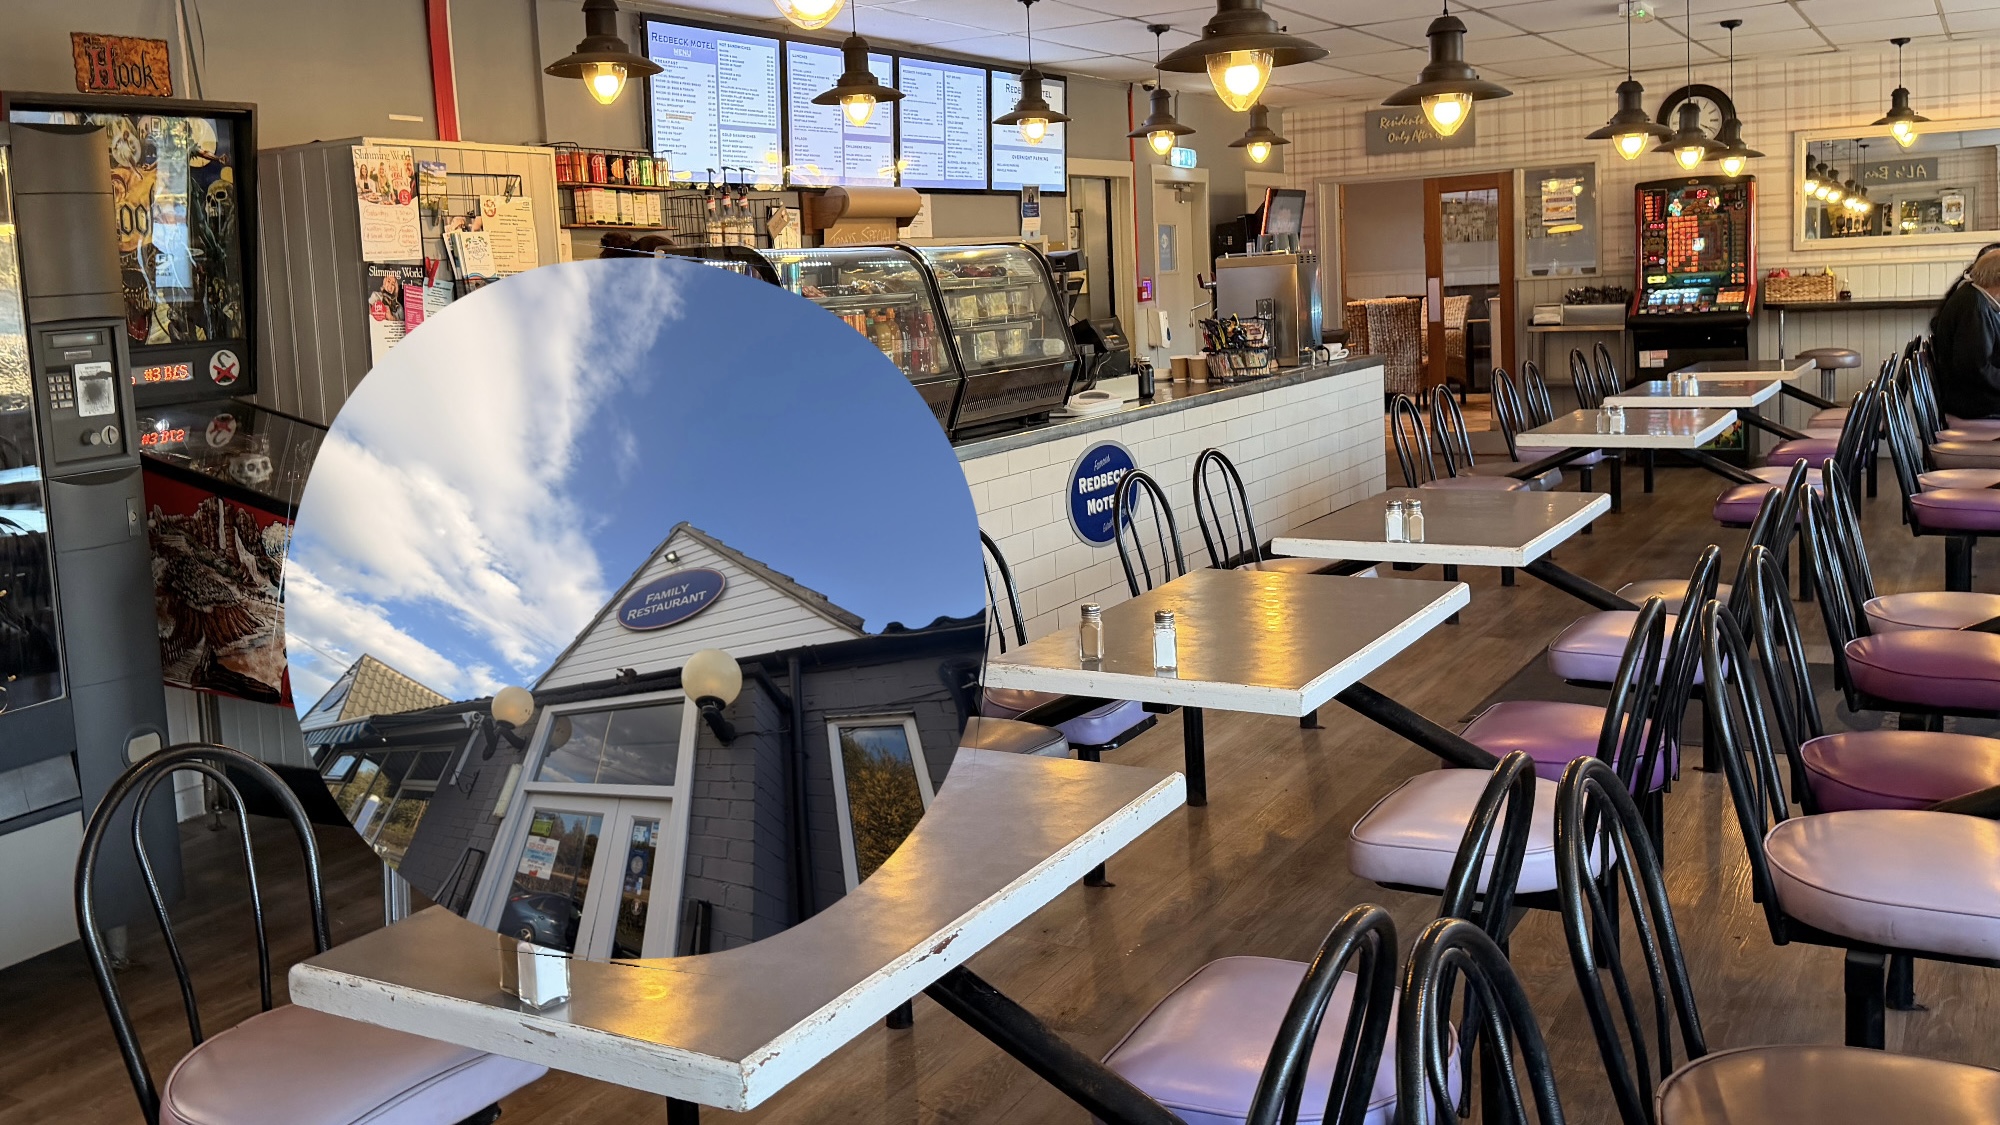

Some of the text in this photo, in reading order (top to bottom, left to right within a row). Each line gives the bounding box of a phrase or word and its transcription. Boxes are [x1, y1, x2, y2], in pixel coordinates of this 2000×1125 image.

[651, 32, 715, 50] REDBECK MOTEL
[673, 48, 692, 58] MENU
[1388, 131, 1410, 144] Only
[354, 148, 390, 161] Slimming
[368, 265, 423, 279] Slimming World
[1086, 494, 1115, 516] MOTE
[645, 583, 690, 605] FAMILY
[626, 590, 707, 621] RESTAURANT
